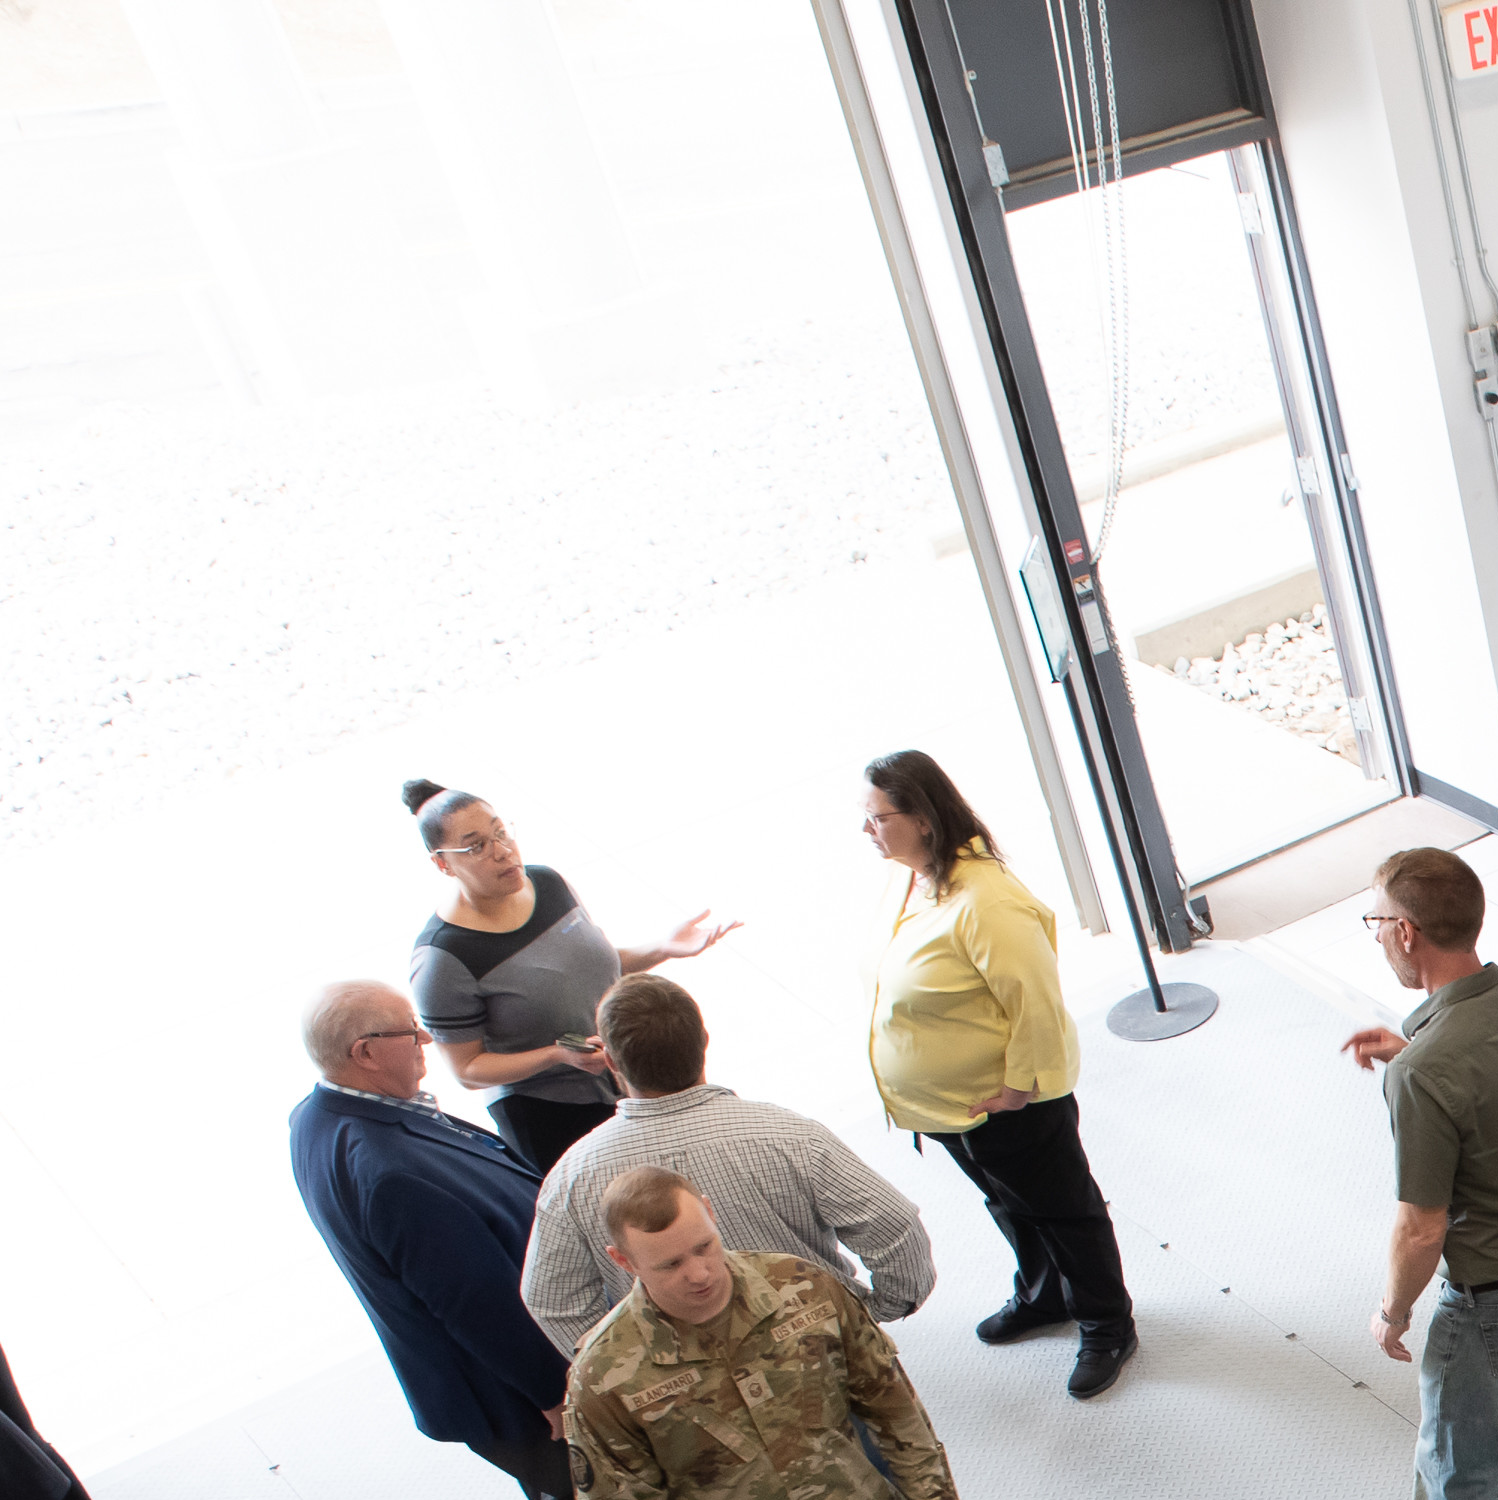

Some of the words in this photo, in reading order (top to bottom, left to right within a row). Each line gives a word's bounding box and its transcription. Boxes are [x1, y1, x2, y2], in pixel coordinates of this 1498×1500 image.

[775, 1326, 788, 1340] US
[792, 1317, 808, 1334] AIR
[807, 1304, 830, 1326] FORCE
[631, 1372, 696, 1409] BLANCHARD
